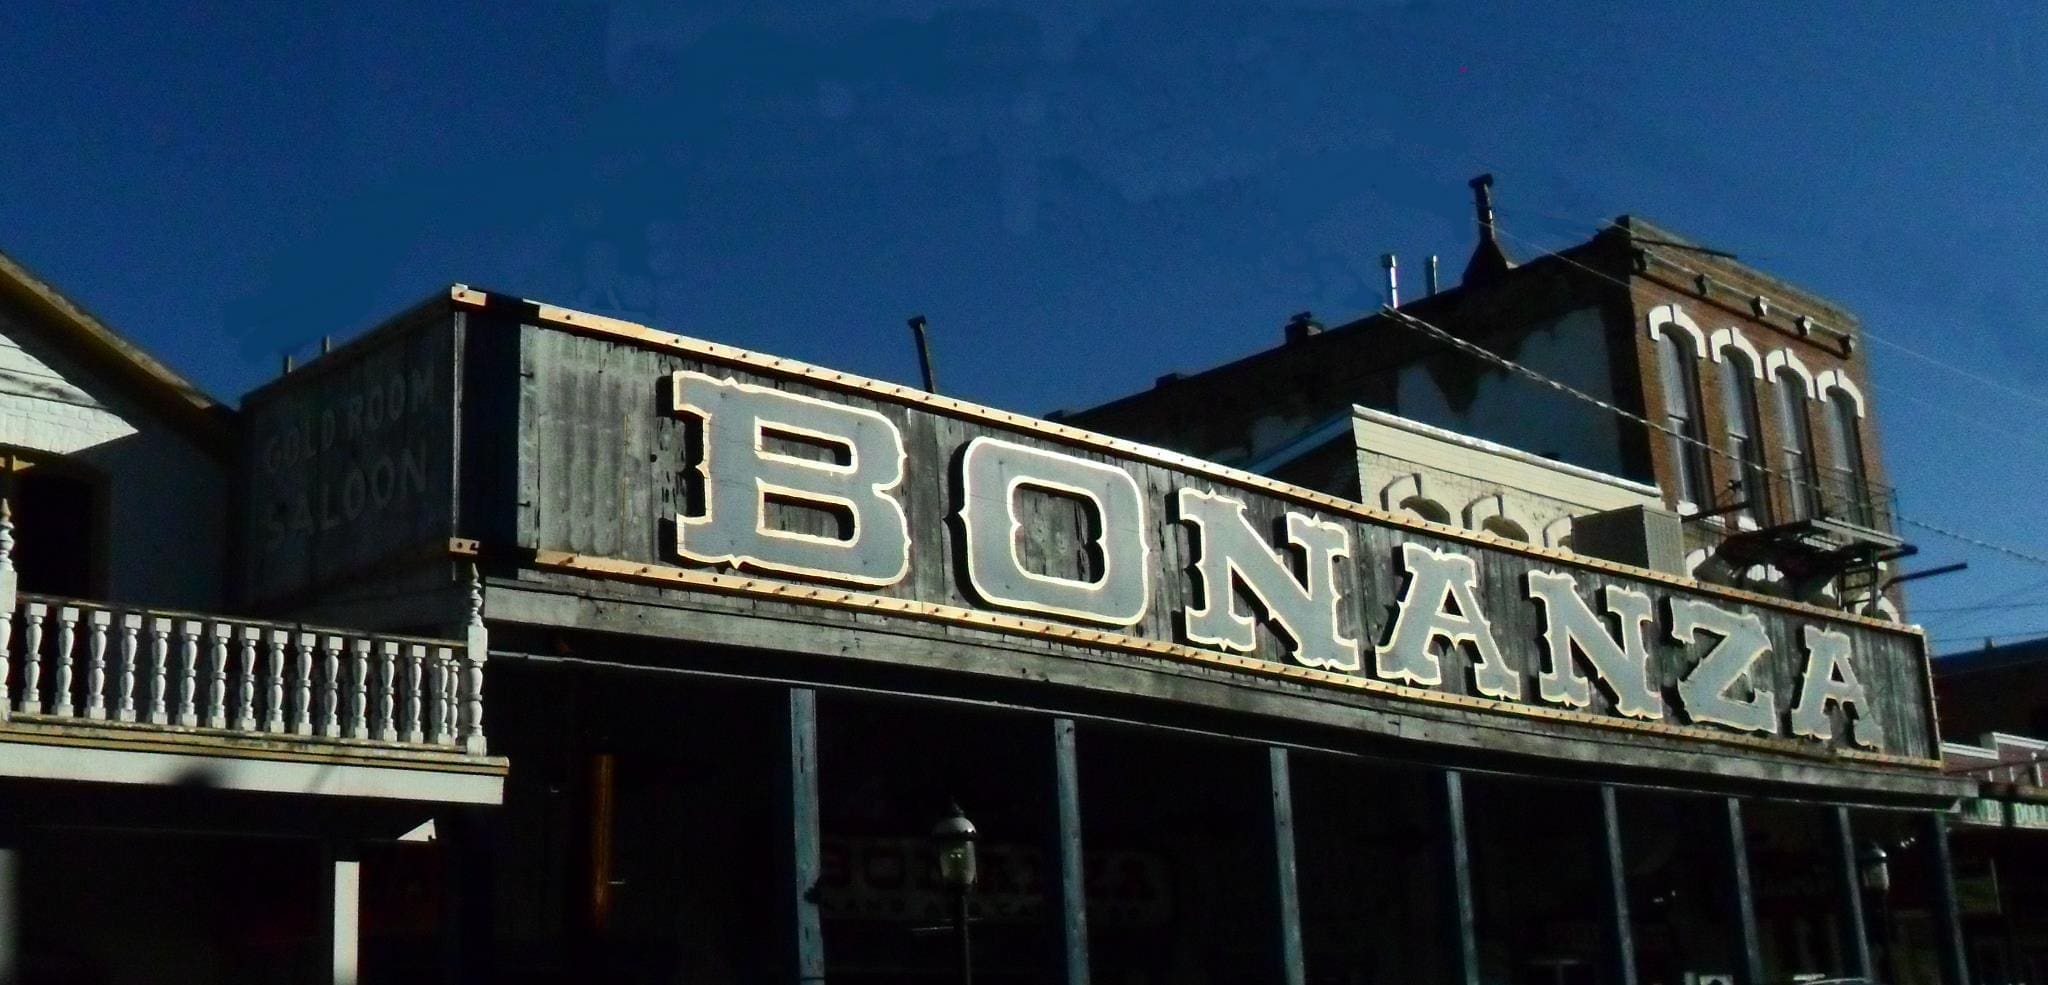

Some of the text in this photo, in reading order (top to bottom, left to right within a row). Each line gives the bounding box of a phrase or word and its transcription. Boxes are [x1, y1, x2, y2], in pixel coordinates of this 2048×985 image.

[263, 366, 434, 474] GOLD ROOM
[258, 438, 429, 552] SALOON
[672, 369, 1886, 751] BONANZA
